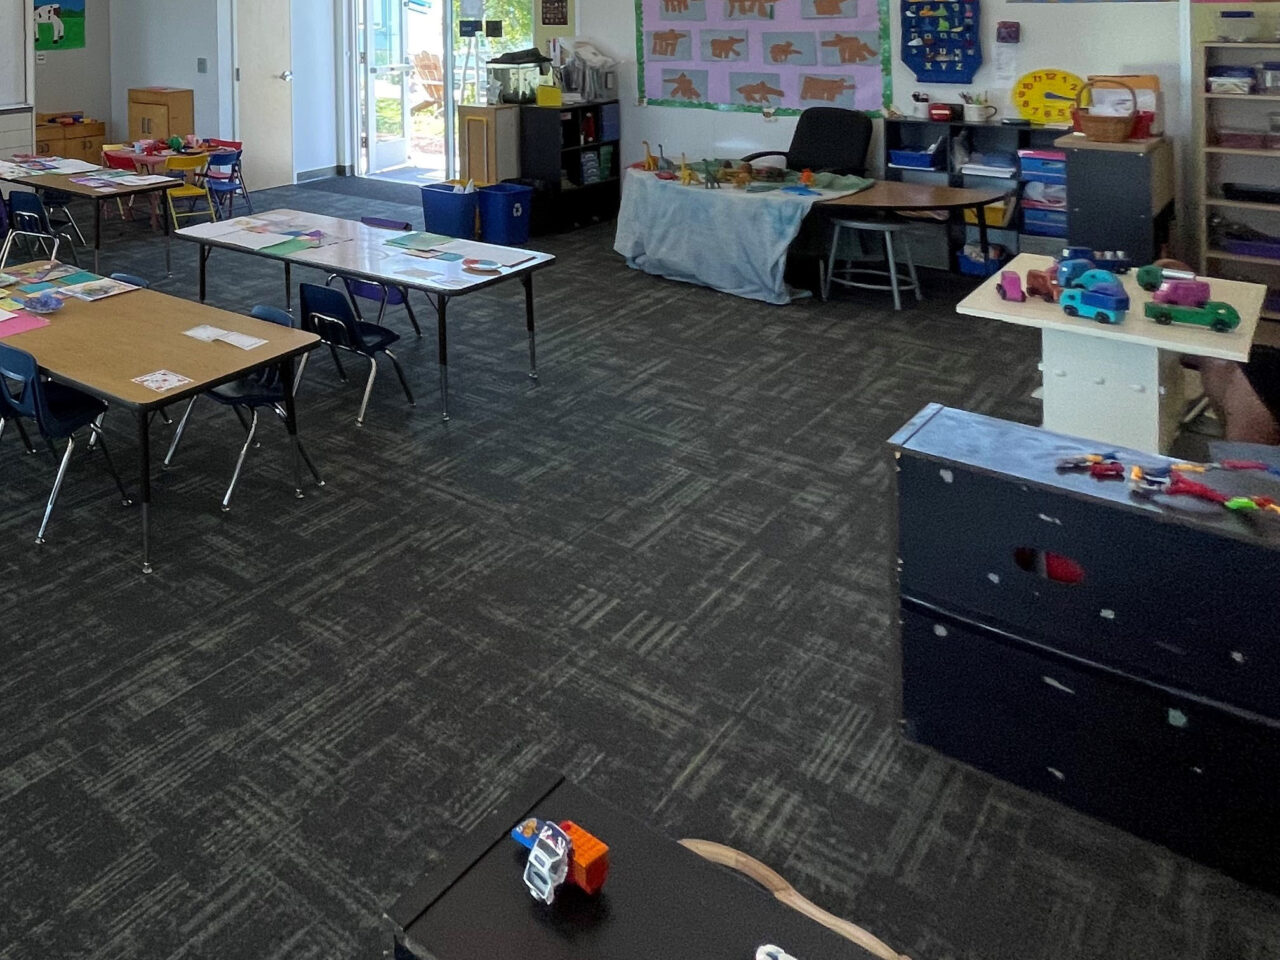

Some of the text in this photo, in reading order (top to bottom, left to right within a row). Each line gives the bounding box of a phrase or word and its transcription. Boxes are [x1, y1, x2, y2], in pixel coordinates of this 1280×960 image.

[1022, 82, 1078, 91] 10 2
[1018, 90, 1025, 98] 9
[1022, 100, 1030, 108] 8
[1032, 107, 1065, 118] 7 6 5
